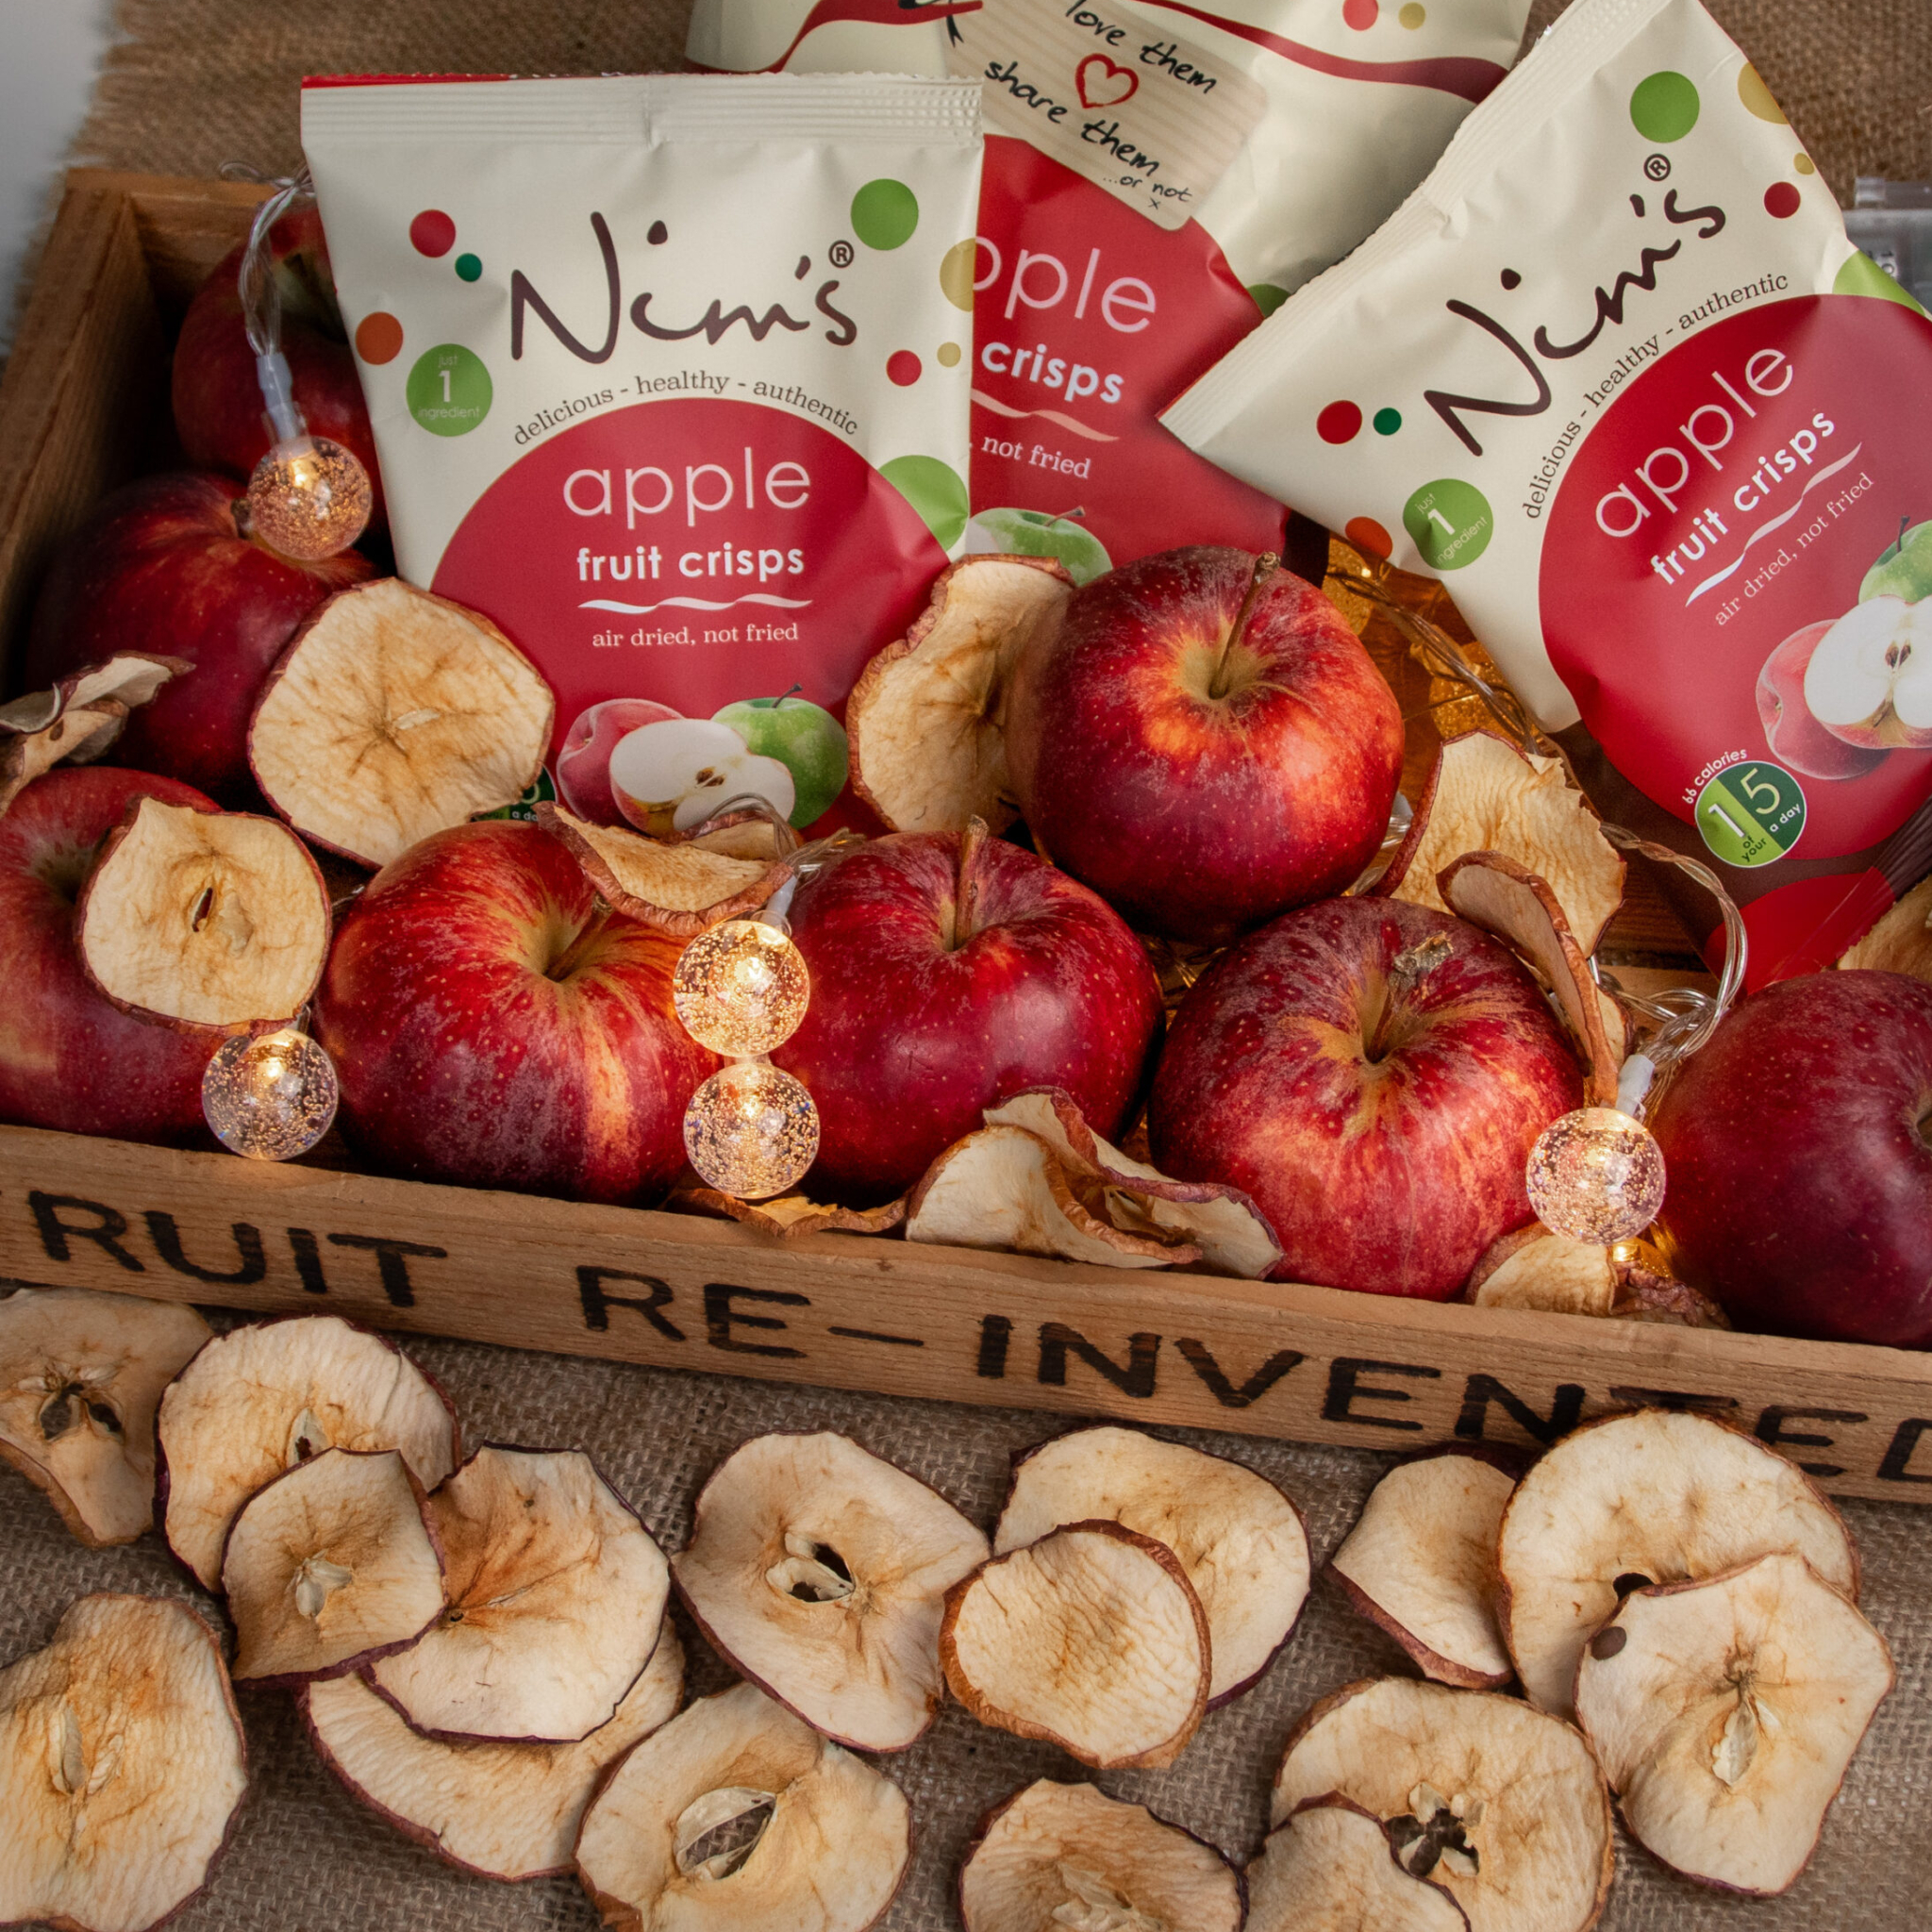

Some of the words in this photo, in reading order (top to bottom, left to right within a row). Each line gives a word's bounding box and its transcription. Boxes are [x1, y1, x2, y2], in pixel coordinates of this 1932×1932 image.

[1065, 0, 1126, 46] love
[1139, 42, 1217, 94] them
[984, 61, 1068, 124] share
[1080, 120, 1159, 176] them
[1152, 180, 1192, 202] not
[973, 236, 1157, 333] ple
[439, 370, 451, 403] 1
[981, 341, 1124, 404] crisps
[1523, 421, 1581, 520] delicious
[1584, 334, 1660, 408] healthy
[1678, 274, 1789, 330] authentic
[417, 406, 480, 421] ingredient
[513, 388, 614, 445] delicious
[633, 370, 730, 394] healthy
[753, 380, 858, 436] authentic
[981, 436, 1024, 460] not
[1028, 444, 1091, 479] fried
[1595, 348, 1793, 538] apple
[563, 446, 811, 529] apple
[1415, 492, 1435, 514] just
[1650, 508, 1728, 585] fruit
[1733, 412, 1835, 511] crisps
[1427, 508, 1456, 535] 1
[1436, 516, 1488, 565] ingredient
[576, 545, 661, 581] fruit
[678, 541, 804, 582] crisps
[1715, 598, 1740, 626] air
[1743, 548, 1798, 598] dried,
[1795, 512, 1828, 550] not
[1825, 473, 1875, 520] fried
[592, 629, 624, 647] air
[630, 626, 695, 646] dried,
[704, 626, 739, 644] not
[745, 623, 799, 642] fried
[1682, 788, 1697, 804] 66
[1694, 749, 1748, 786] calories
[1708, 804, 1745, 838] 1
[1740, 767, 1781, 814] 5
[524, 812, 539, 821] da
[1742, 836, 1756, 849] of
[1769, 824, 1779, 832] a
[1779, 803, 1802, 824] day
[1741, 838, 1767, 862] your
[0, 1190, 448, 1307] RUIT
